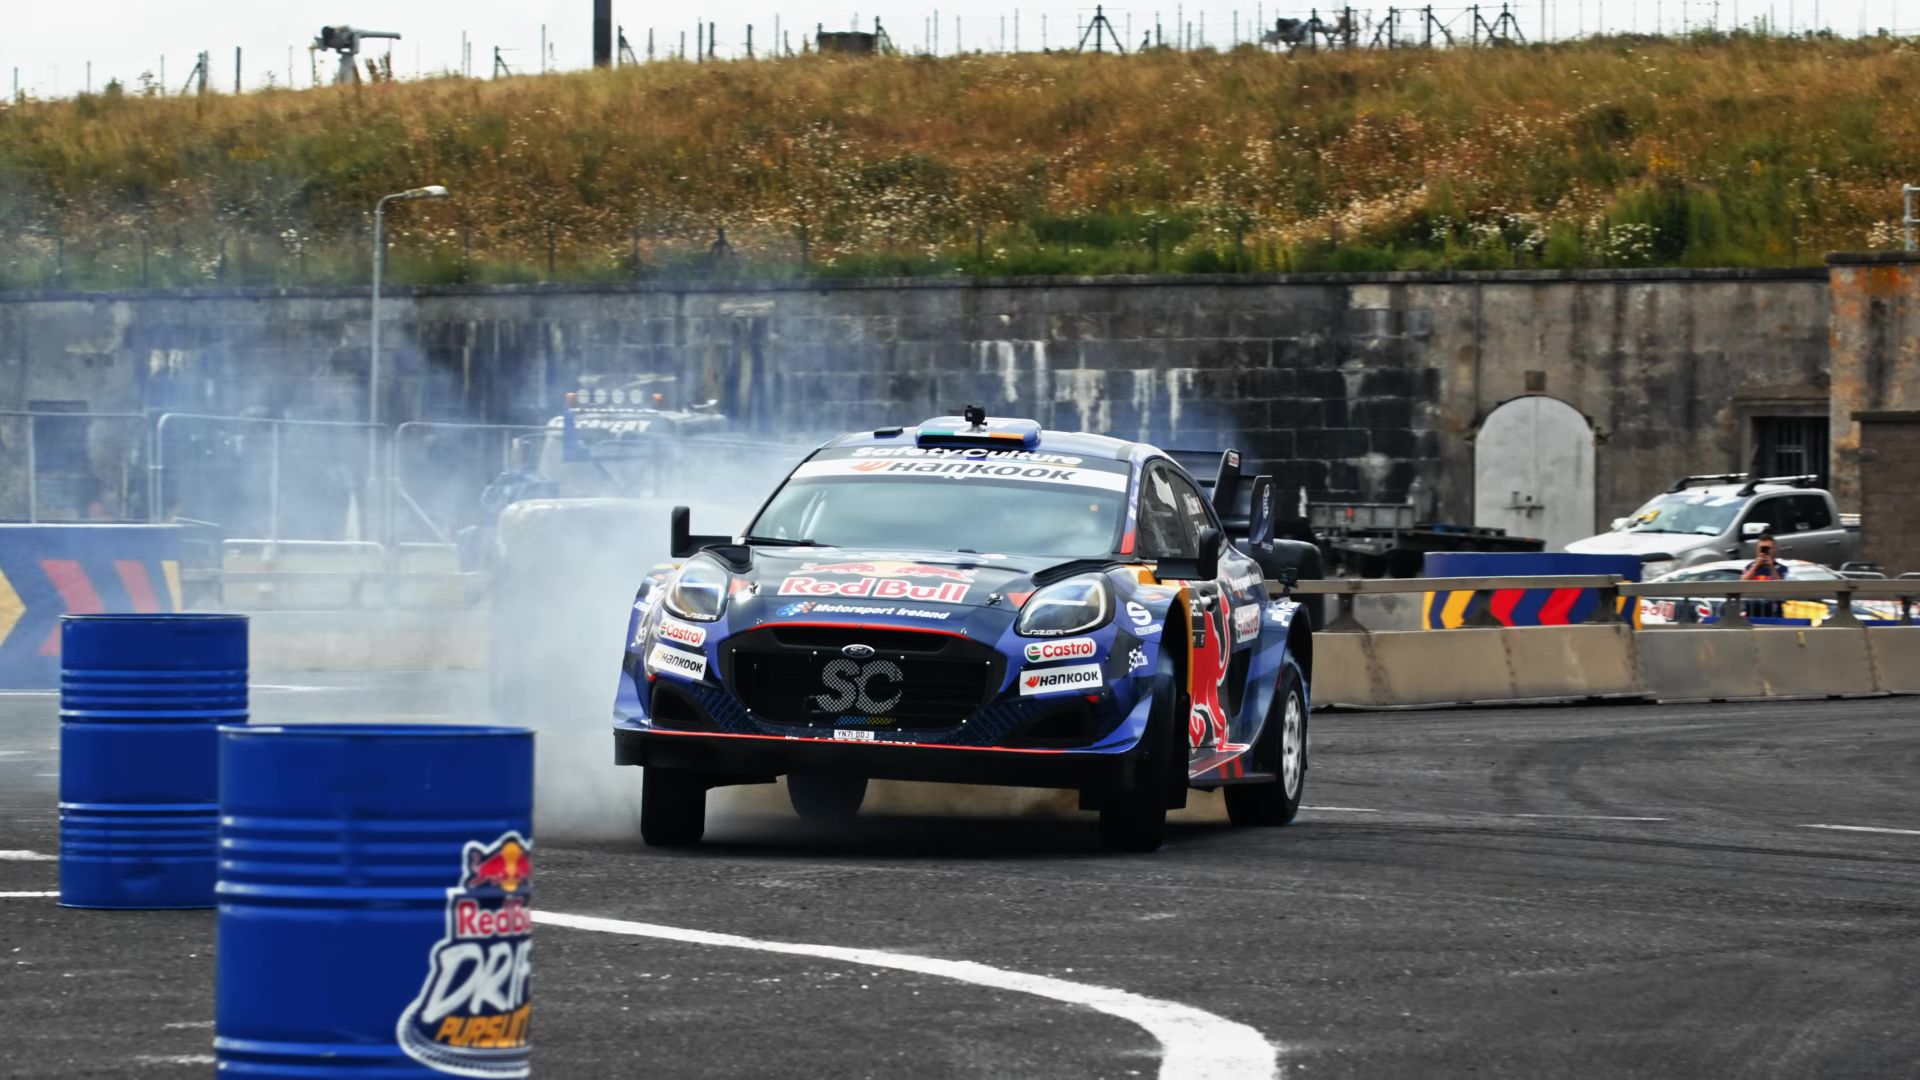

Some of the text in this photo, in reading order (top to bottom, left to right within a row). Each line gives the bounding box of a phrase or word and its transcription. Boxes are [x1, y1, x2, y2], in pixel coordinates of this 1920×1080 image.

[851, 446, 1084, 465] SafetyCulture
[777, 577, 972, 604] Red Bull
[813, 604, 951, 620] Motorsport Ireland
[666, 624, 703, 644] Castrol
[1042, 643, 1093, 658] Castrol
[816, 658, 904, 714] SC
